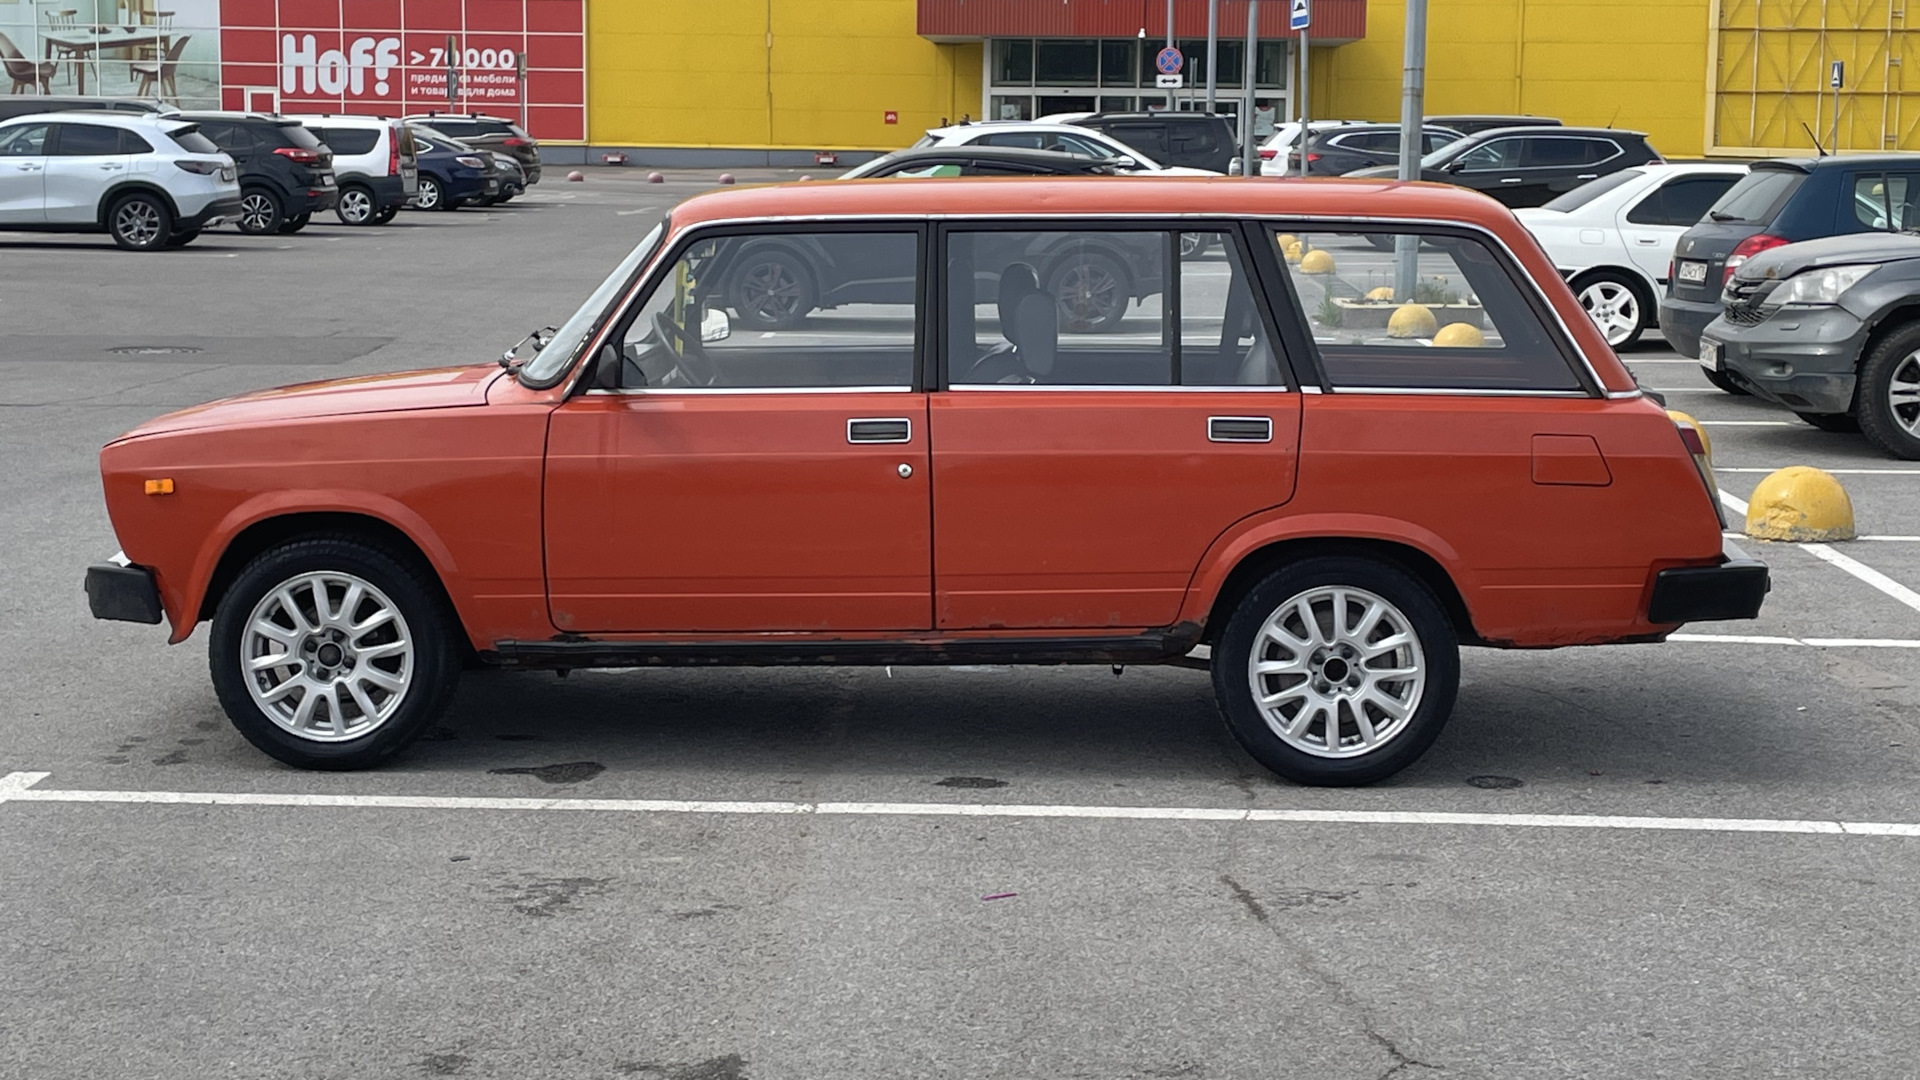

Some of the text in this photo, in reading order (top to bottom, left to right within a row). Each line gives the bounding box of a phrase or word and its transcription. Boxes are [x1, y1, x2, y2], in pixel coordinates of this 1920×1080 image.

[410, 74, 516, 84] предмов мебели
[410, 87, 516, 98] и товав для дома
